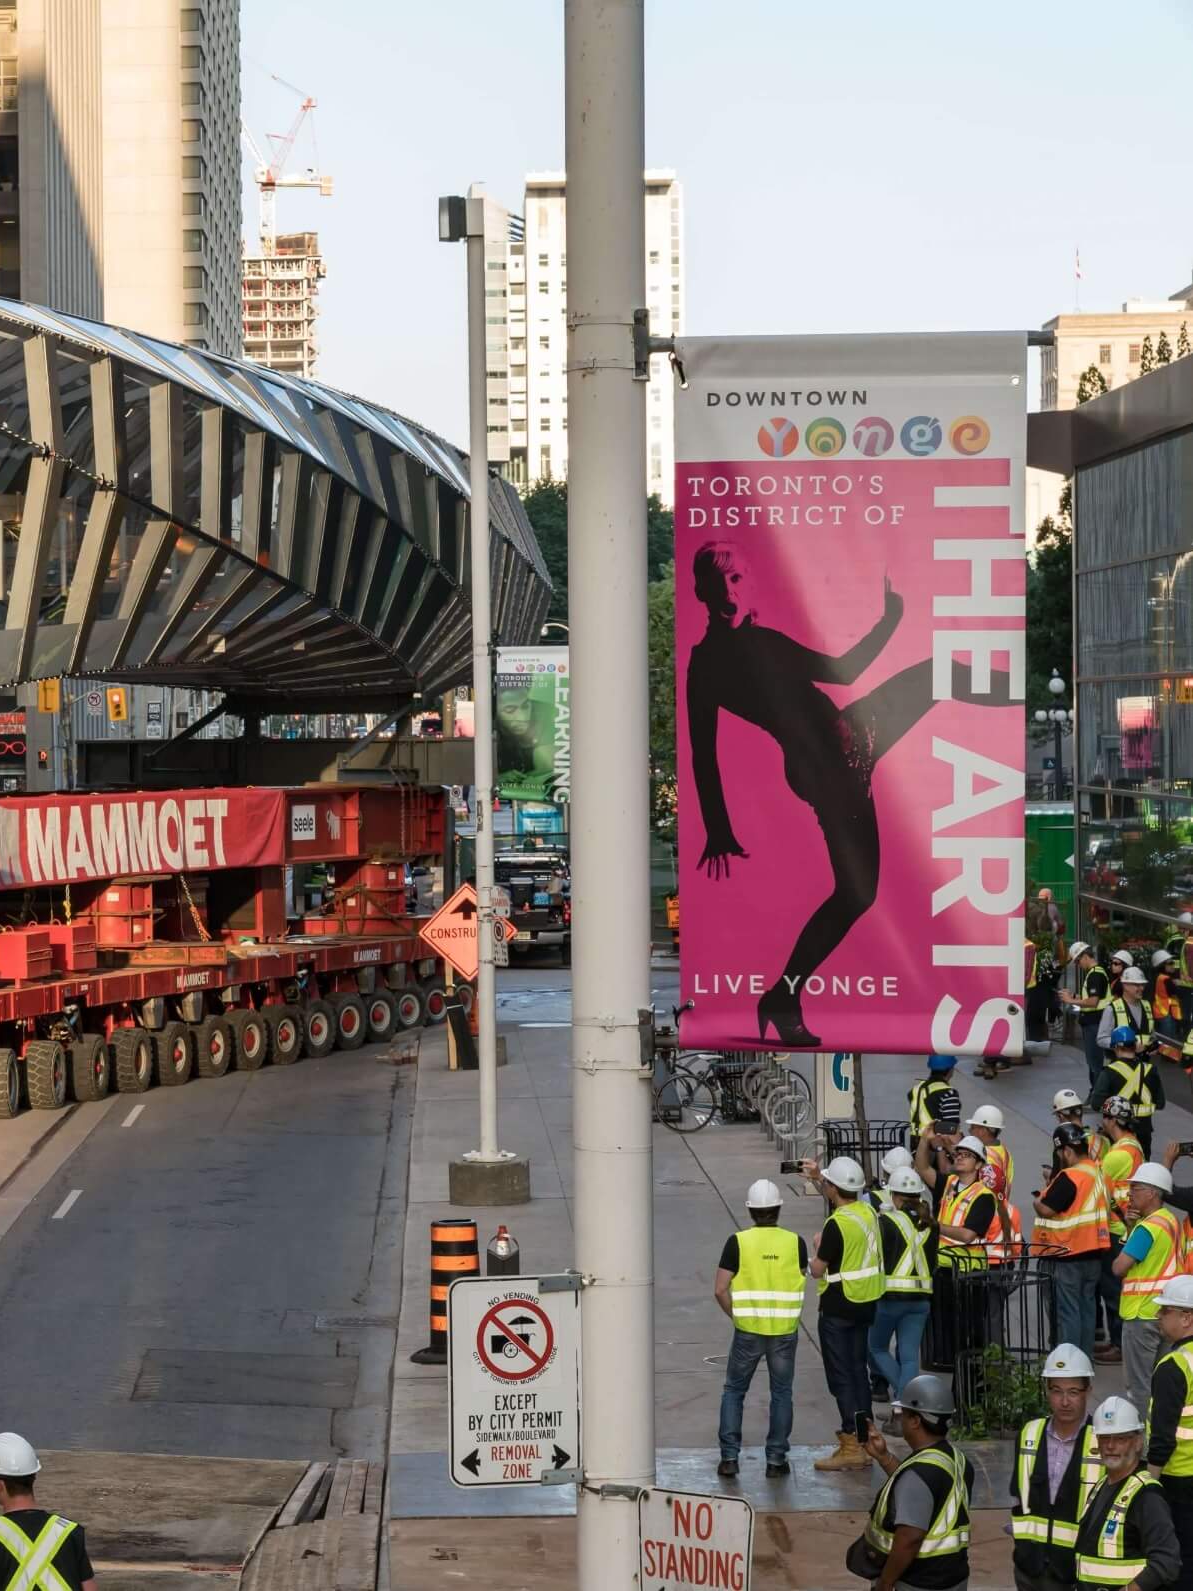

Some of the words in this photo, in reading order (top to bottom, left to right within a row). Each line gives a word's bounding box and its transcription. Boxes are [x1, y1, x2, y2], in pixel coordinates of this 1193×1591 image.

[706, 389, 868, 407] DOWNTOWN
[687, 474, 885, 497] TORONTO'S
[687, 505, 847, 528] DISTRICT
[863, 504, 906, 525] OF
[932, 457, 1027, 700] THE
[553, 672, 571, 804] LEARNING
[294, 814, 314, 832] seele
[25, 798, 228, 883] MAMMOET
[931, 735, 1026, 1057] ARTS
[430, 927, 476, 939] CONSTRU
[176, 971, 210, 988] MAMMOET
[693, 974, 765, 995] LIVE
[782, 975, 899, 997] YONGE
[487, 1296, 500, 1307] NO
[503, 1292, 540, 1305] VENDING
[490, 1374, 518, 1386] TORONTO
[494, 1393, 538, 1411] EXCEPT
[468, 1414, 484, 1431] BY
[489, 1413, 516, 1431] CITY
[522, 1410, 563, 1429] PERMIT
[476, 1429, 556, 1443] SIDEWALK/BOULEVARD
[491, 1444, 542, 1461] REMOVAL
[502, 1463, 533, 1479] ZONE
[674, 1499, 713, 1541] NO
[644, 1539, 744, 1591] STANDING
